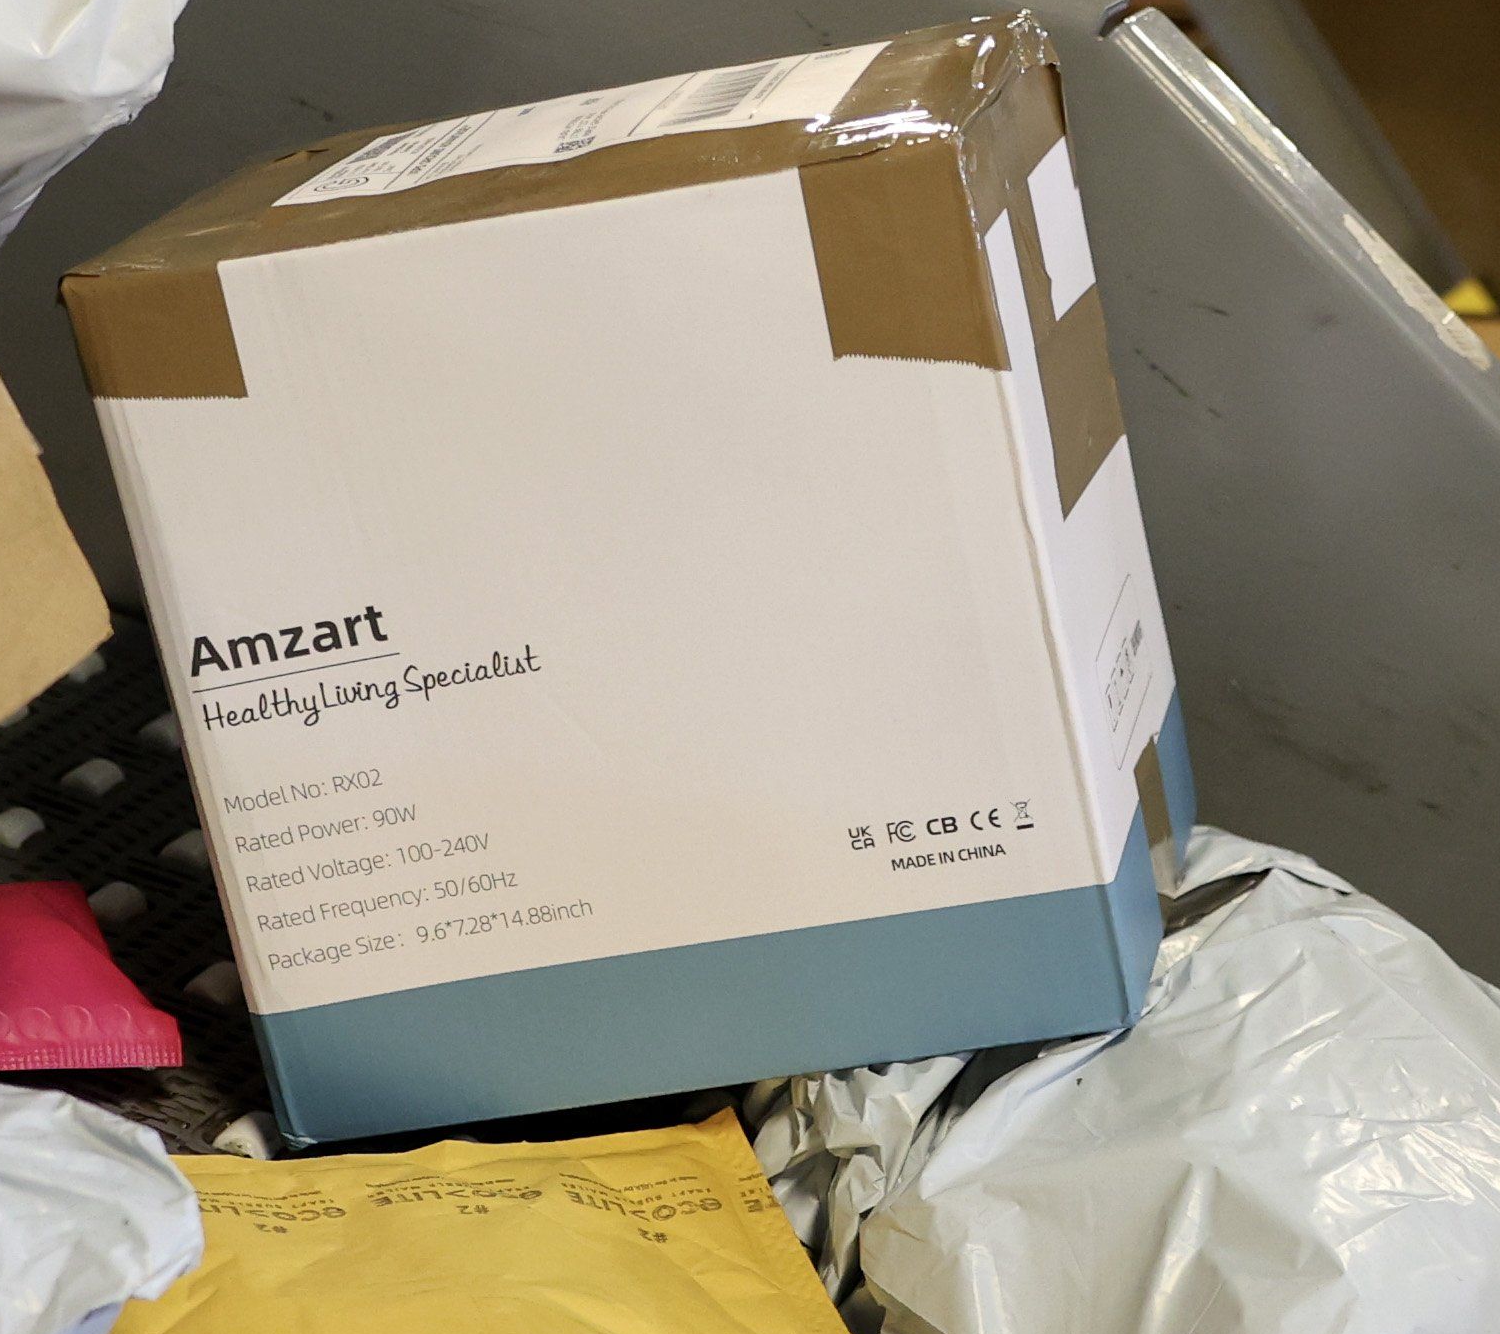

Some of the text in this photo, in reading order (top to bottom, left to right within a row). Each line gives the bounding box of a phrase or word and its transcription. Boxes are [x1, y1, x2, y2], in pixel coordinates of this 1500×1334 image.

[190, 605, 388, 677] Amzart
[202, 644, 542, 731] Healthy Living Specialist
[223, 768, 383, 814] Model No: RX02
[234, 803, 417, 854] Rated Power: 90W
[926, 816, 958, 836] CB
[970, 808, 1002, 831] CE
[246, 832, 489, 893] Rated Voltage: 100-240V
[891, 844, 1006, 871] MADE IN CHINA
[257, 870, 519, 932] Rated Frequency: 50/60Hz
[268, 941, 352, 970] Package
[456, 1203, 490, 1215] #2
[637, 1226, 669, 1244] #2
